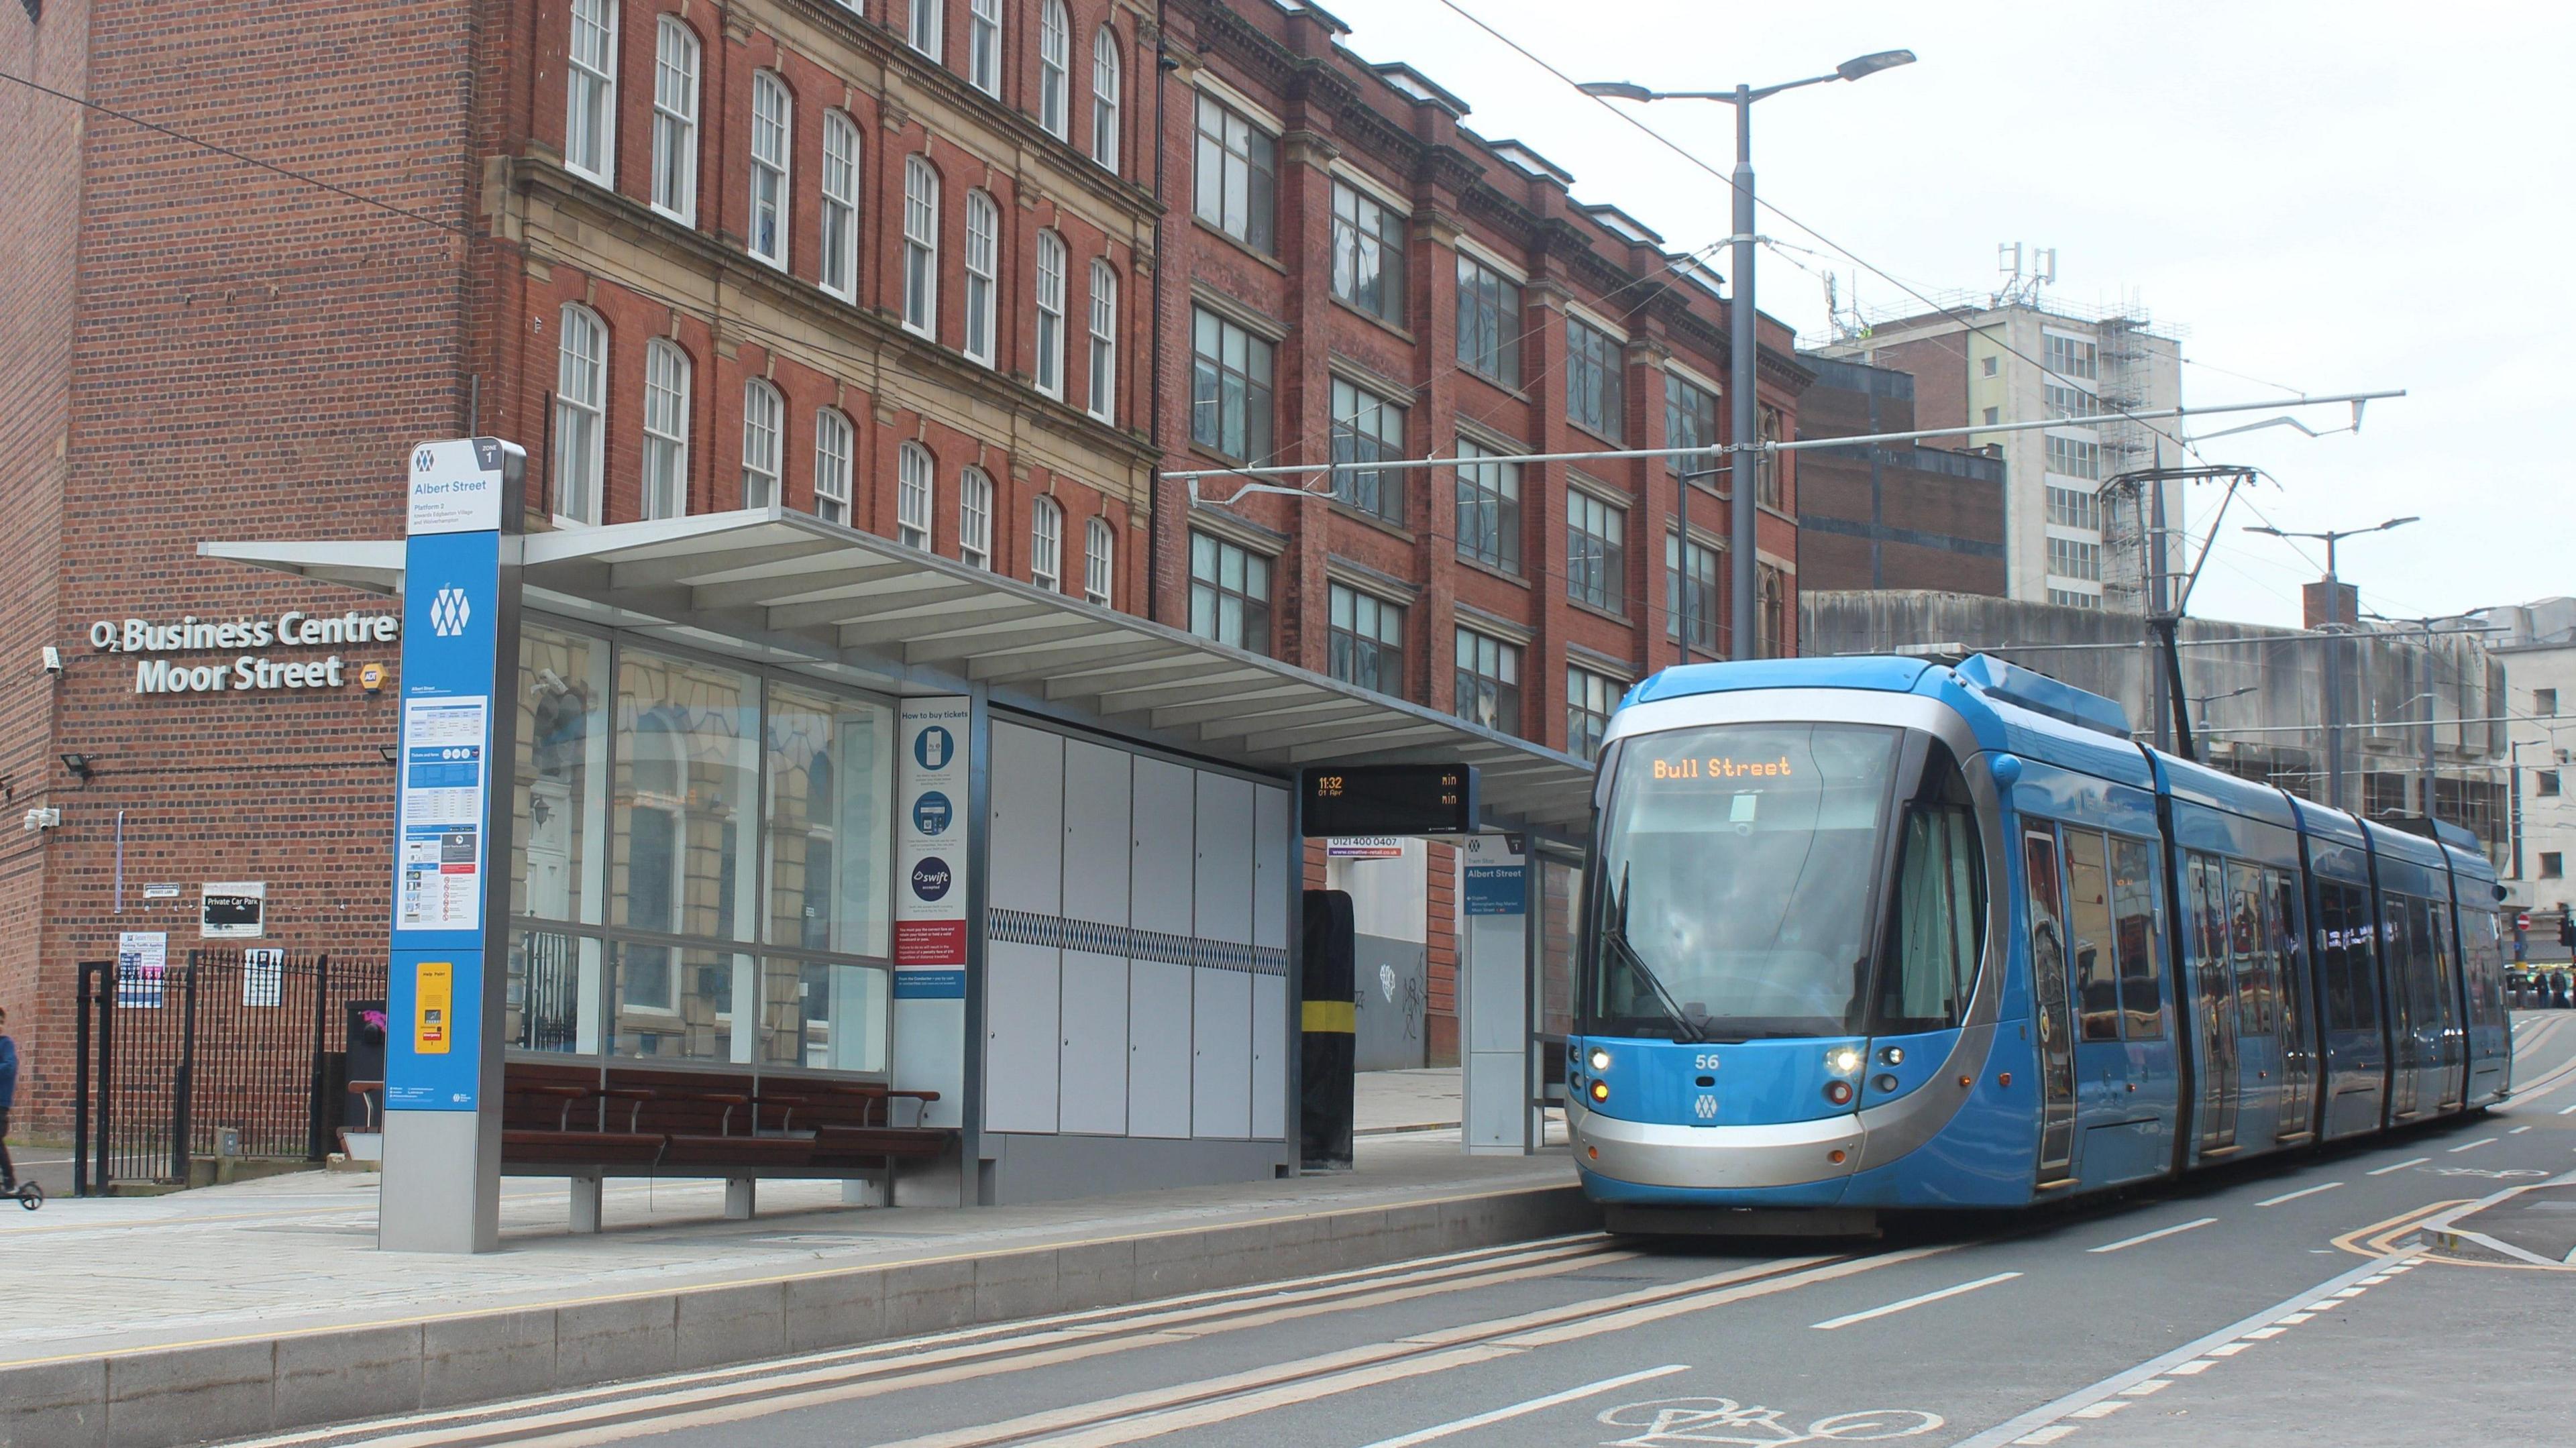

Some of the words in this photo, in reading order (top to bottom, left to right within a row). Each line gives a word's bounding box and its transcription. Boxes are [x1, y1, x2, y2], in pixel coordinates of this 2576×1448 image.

[486, 451, 492, 463] 1
[415, 483, 449, 495] Albert
[452, 480, 486, 492] Street
[423, 518, 459, 526] Wolverhampton
[123, 615, 274, 652] Business
[277, 611, 398, 646] Centre
[136, 659, 231, 693] Moor
[233, 655, 345, 691] Street
[365, 672, 377, 681] ADT
[902, 712, 919, 720] How
[920, 711, 928, 719] to
[929, 711, 943, 720] buy
[944, 710, 968, 718] tickets
[1654, 759, 1699, 779] Bull
[1708, 756, 1792, 777] Street
[1319, 777, 1342, 789] 11:32
[1442, 773, 1456, 785] min
[1442, 792, 1456, 805] min
[1333, 838, 1351, 846] 0121
[1353, 838, 1371, 846] 400
[1373, 838, 1397, 846] 0407
[923, 871, 948, 885] swift
[1468, 869, 1494, 878] Albert
[1495, 869, 1521, 877] Street
[1695, 1054, 1719, 1070] 56
